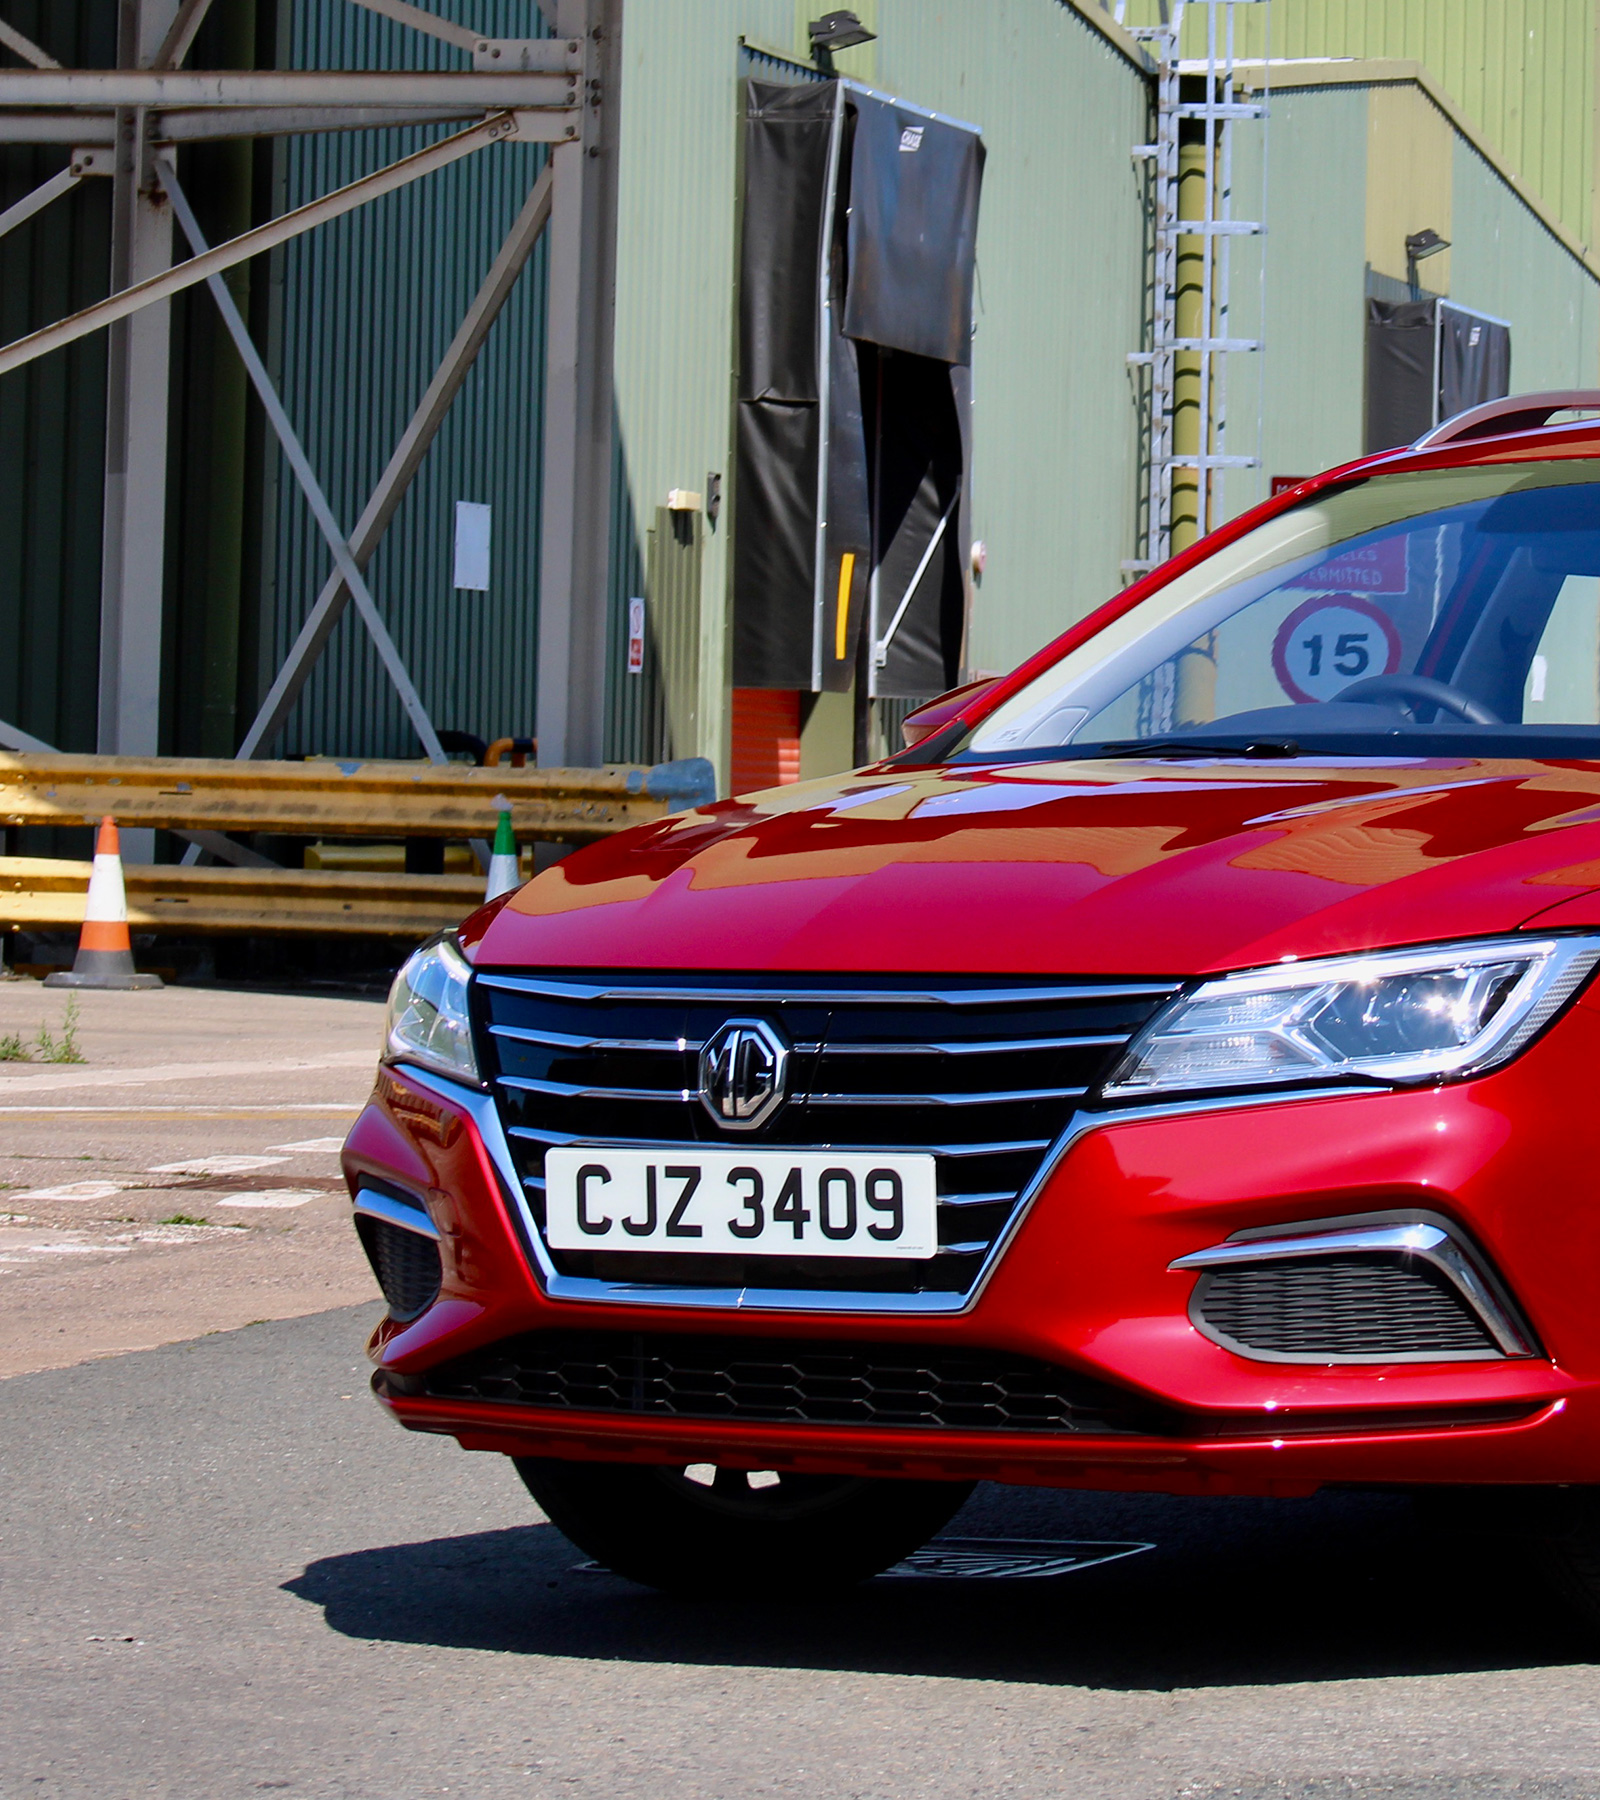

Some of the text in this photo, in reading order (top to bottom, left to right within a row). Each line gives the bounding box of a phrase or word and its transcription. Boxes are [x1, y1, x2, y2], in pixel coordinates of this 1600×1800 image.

[1302, 633, 1369, 677] 15
[706, 1030, 774, 1116] MG
[576, 1164, 904, 1241] CJZ 3409
